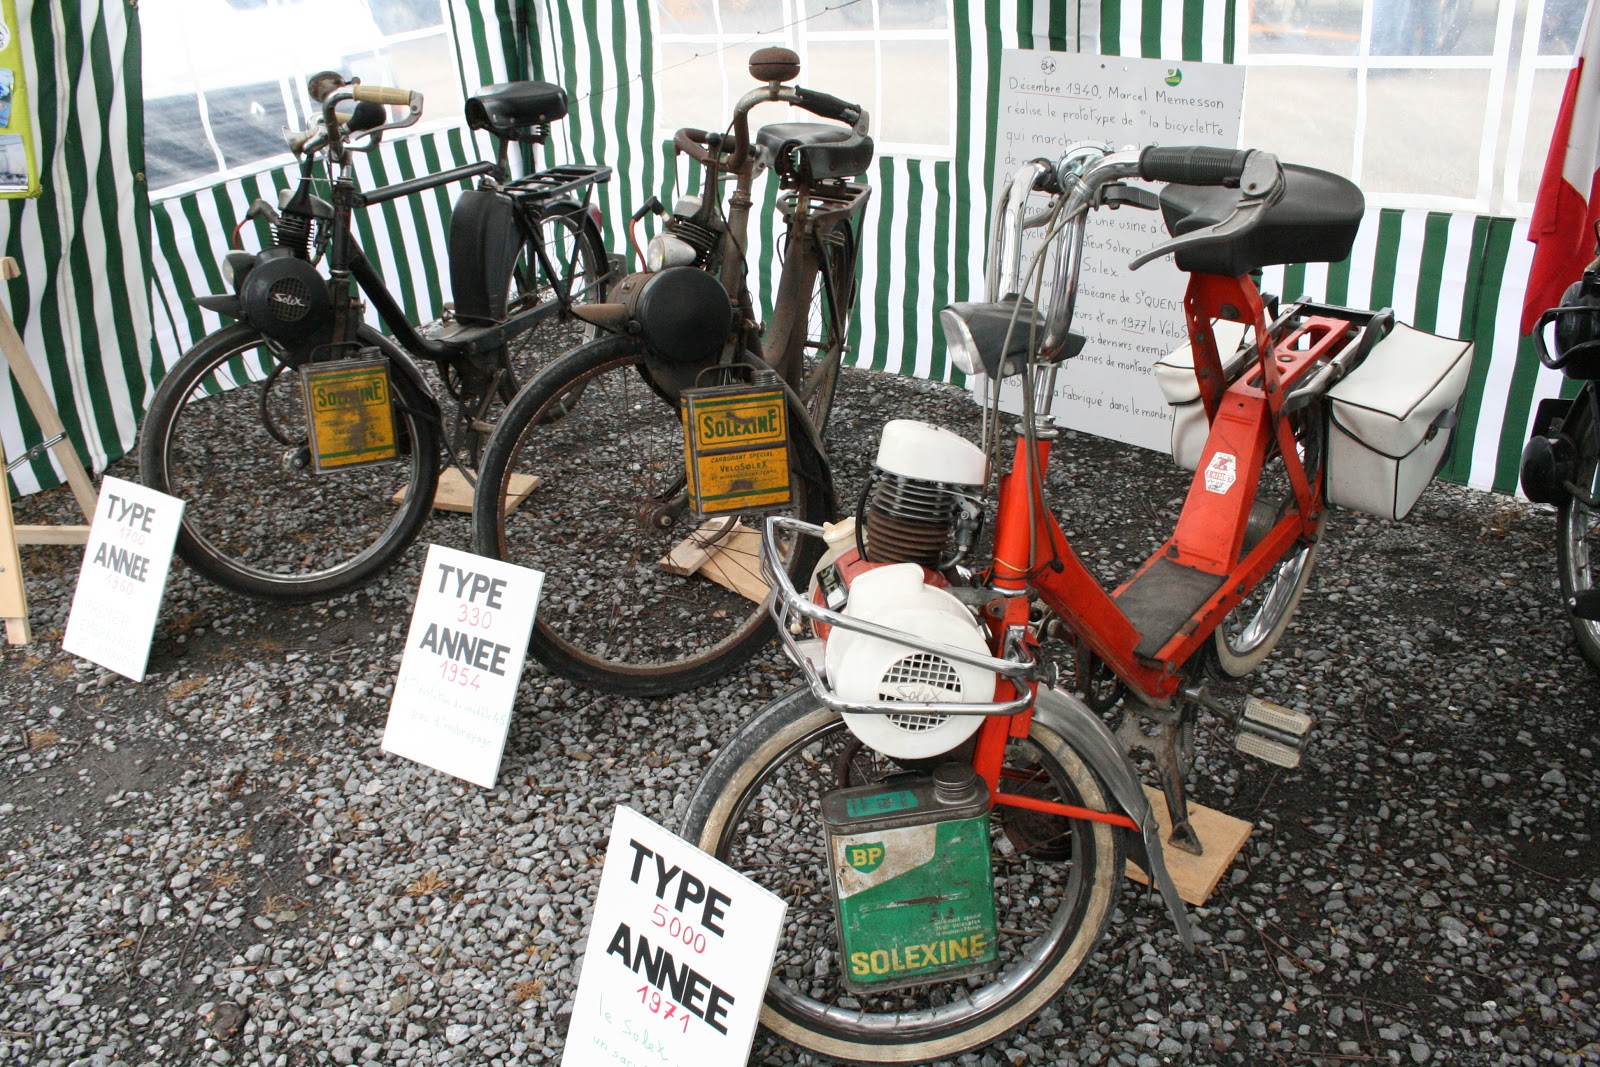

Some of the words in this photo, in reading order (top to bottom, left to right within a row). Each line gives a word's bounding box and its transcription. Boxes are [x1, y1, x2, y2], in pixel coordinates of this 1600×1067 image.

[1008, 76, 1061, 94] Décembre
[1108, 86, 1148, 102] Marcel
[1156, 90, 1224, 109] Mennesson
[1007, 101, 1042, 117] réalise
[1047, 105, 1056, 118] le
[1063, 108, 1115, 126] prototype
[1122, 110, 1133, 126] de
[1165, 116, 1224, 137] bicyclette
[1006, 129, 1025, 145] qui
[1031, 134, 1077, 147] march
[1005, 154, 1017, 166] de
[1095, 218, 1115, 228] une
[1119, 220, 1147, 233] usine
[1105, 238, 1131, 256] Solex
[1119, 288, 1130, 303] de
[1144, 295, 1185, 313] QUENT
[1097, 332, 1132, 351] derniers
[1107, 317, 1118, 326] en
[1121, 316, 1147, 332] 1977
[1159, 319, 1189, 340] VéloS
[1106, 354, 1115, 367] de
[1117, 358, 1152, 376] montage
[1109, 396, 1129, 413] dans
[1141, 406, 1167, 421] monde
[107, 493, 156, 534] TYPE
[119, 527, 146, 546] 1700
[93, 541, 151, 583] ANNEE
[438, 563, 508, 611] TYPE
[456, 603, 493, 630] 330
[419, 622, 511, 677] ANNEE
[439, 660, 481, 691] 1954
[851, 847, 882, 867] BP
[629, 838, 733, 939] TYPE
[651, 903, 706, 954] 5000
[851, 933, 987, 976] SOLEXINE
[606, 922, 736, 1036] ANNEE
[636, 985, 691, 1034] 1971
[599, 992, 613, 1025] le
[621, 1018, 669, 1062] Solex
[593, 1034, 608, 1051] un
